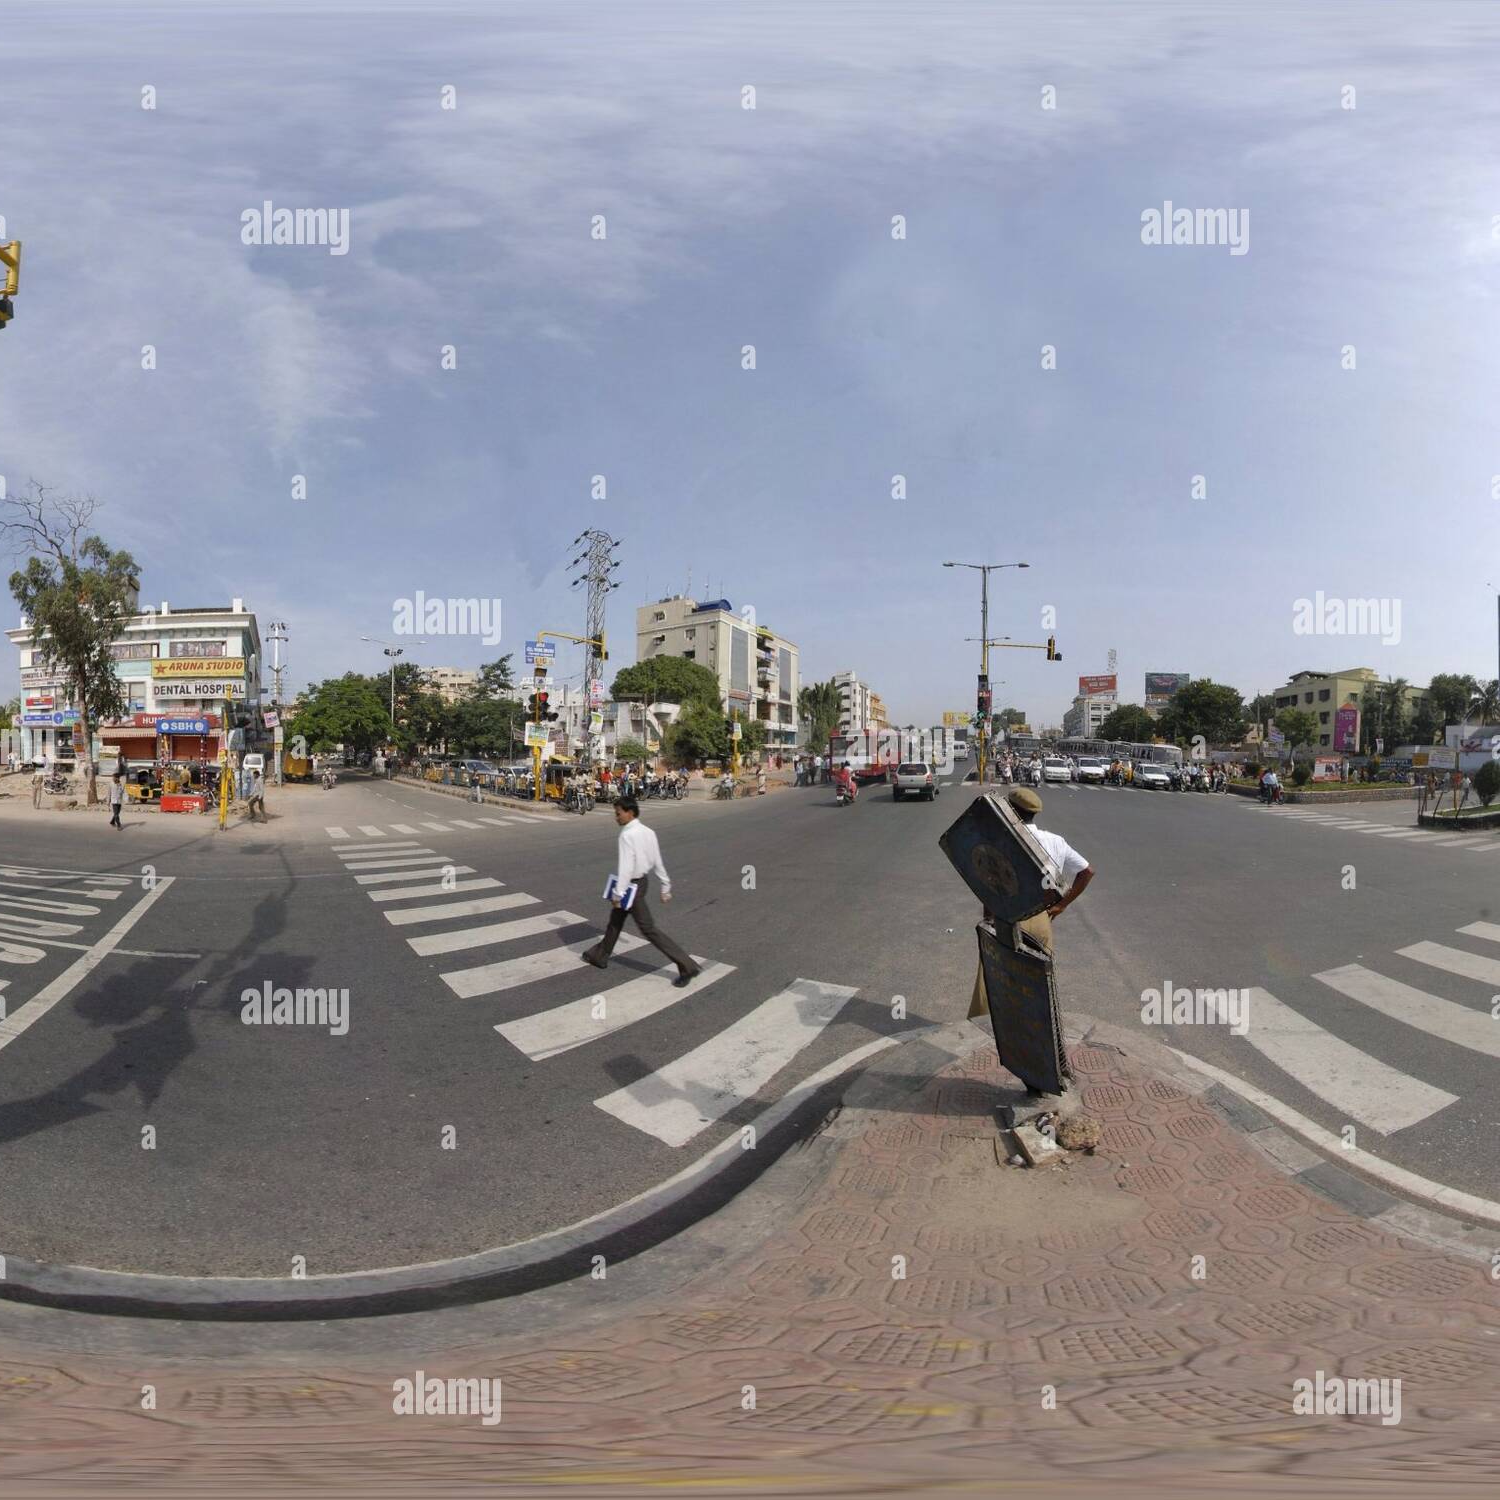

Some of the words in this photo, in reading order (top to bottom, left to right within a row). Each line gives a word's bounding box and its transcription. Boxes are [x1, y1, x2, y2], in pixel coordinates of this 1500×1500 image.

[169, 661, 204, 671] ARUNA
[206, 661, 243, 671] STUDIO
[154, 684, 191, 695] DENTAL
[171, 721, 193, 731] SBH
